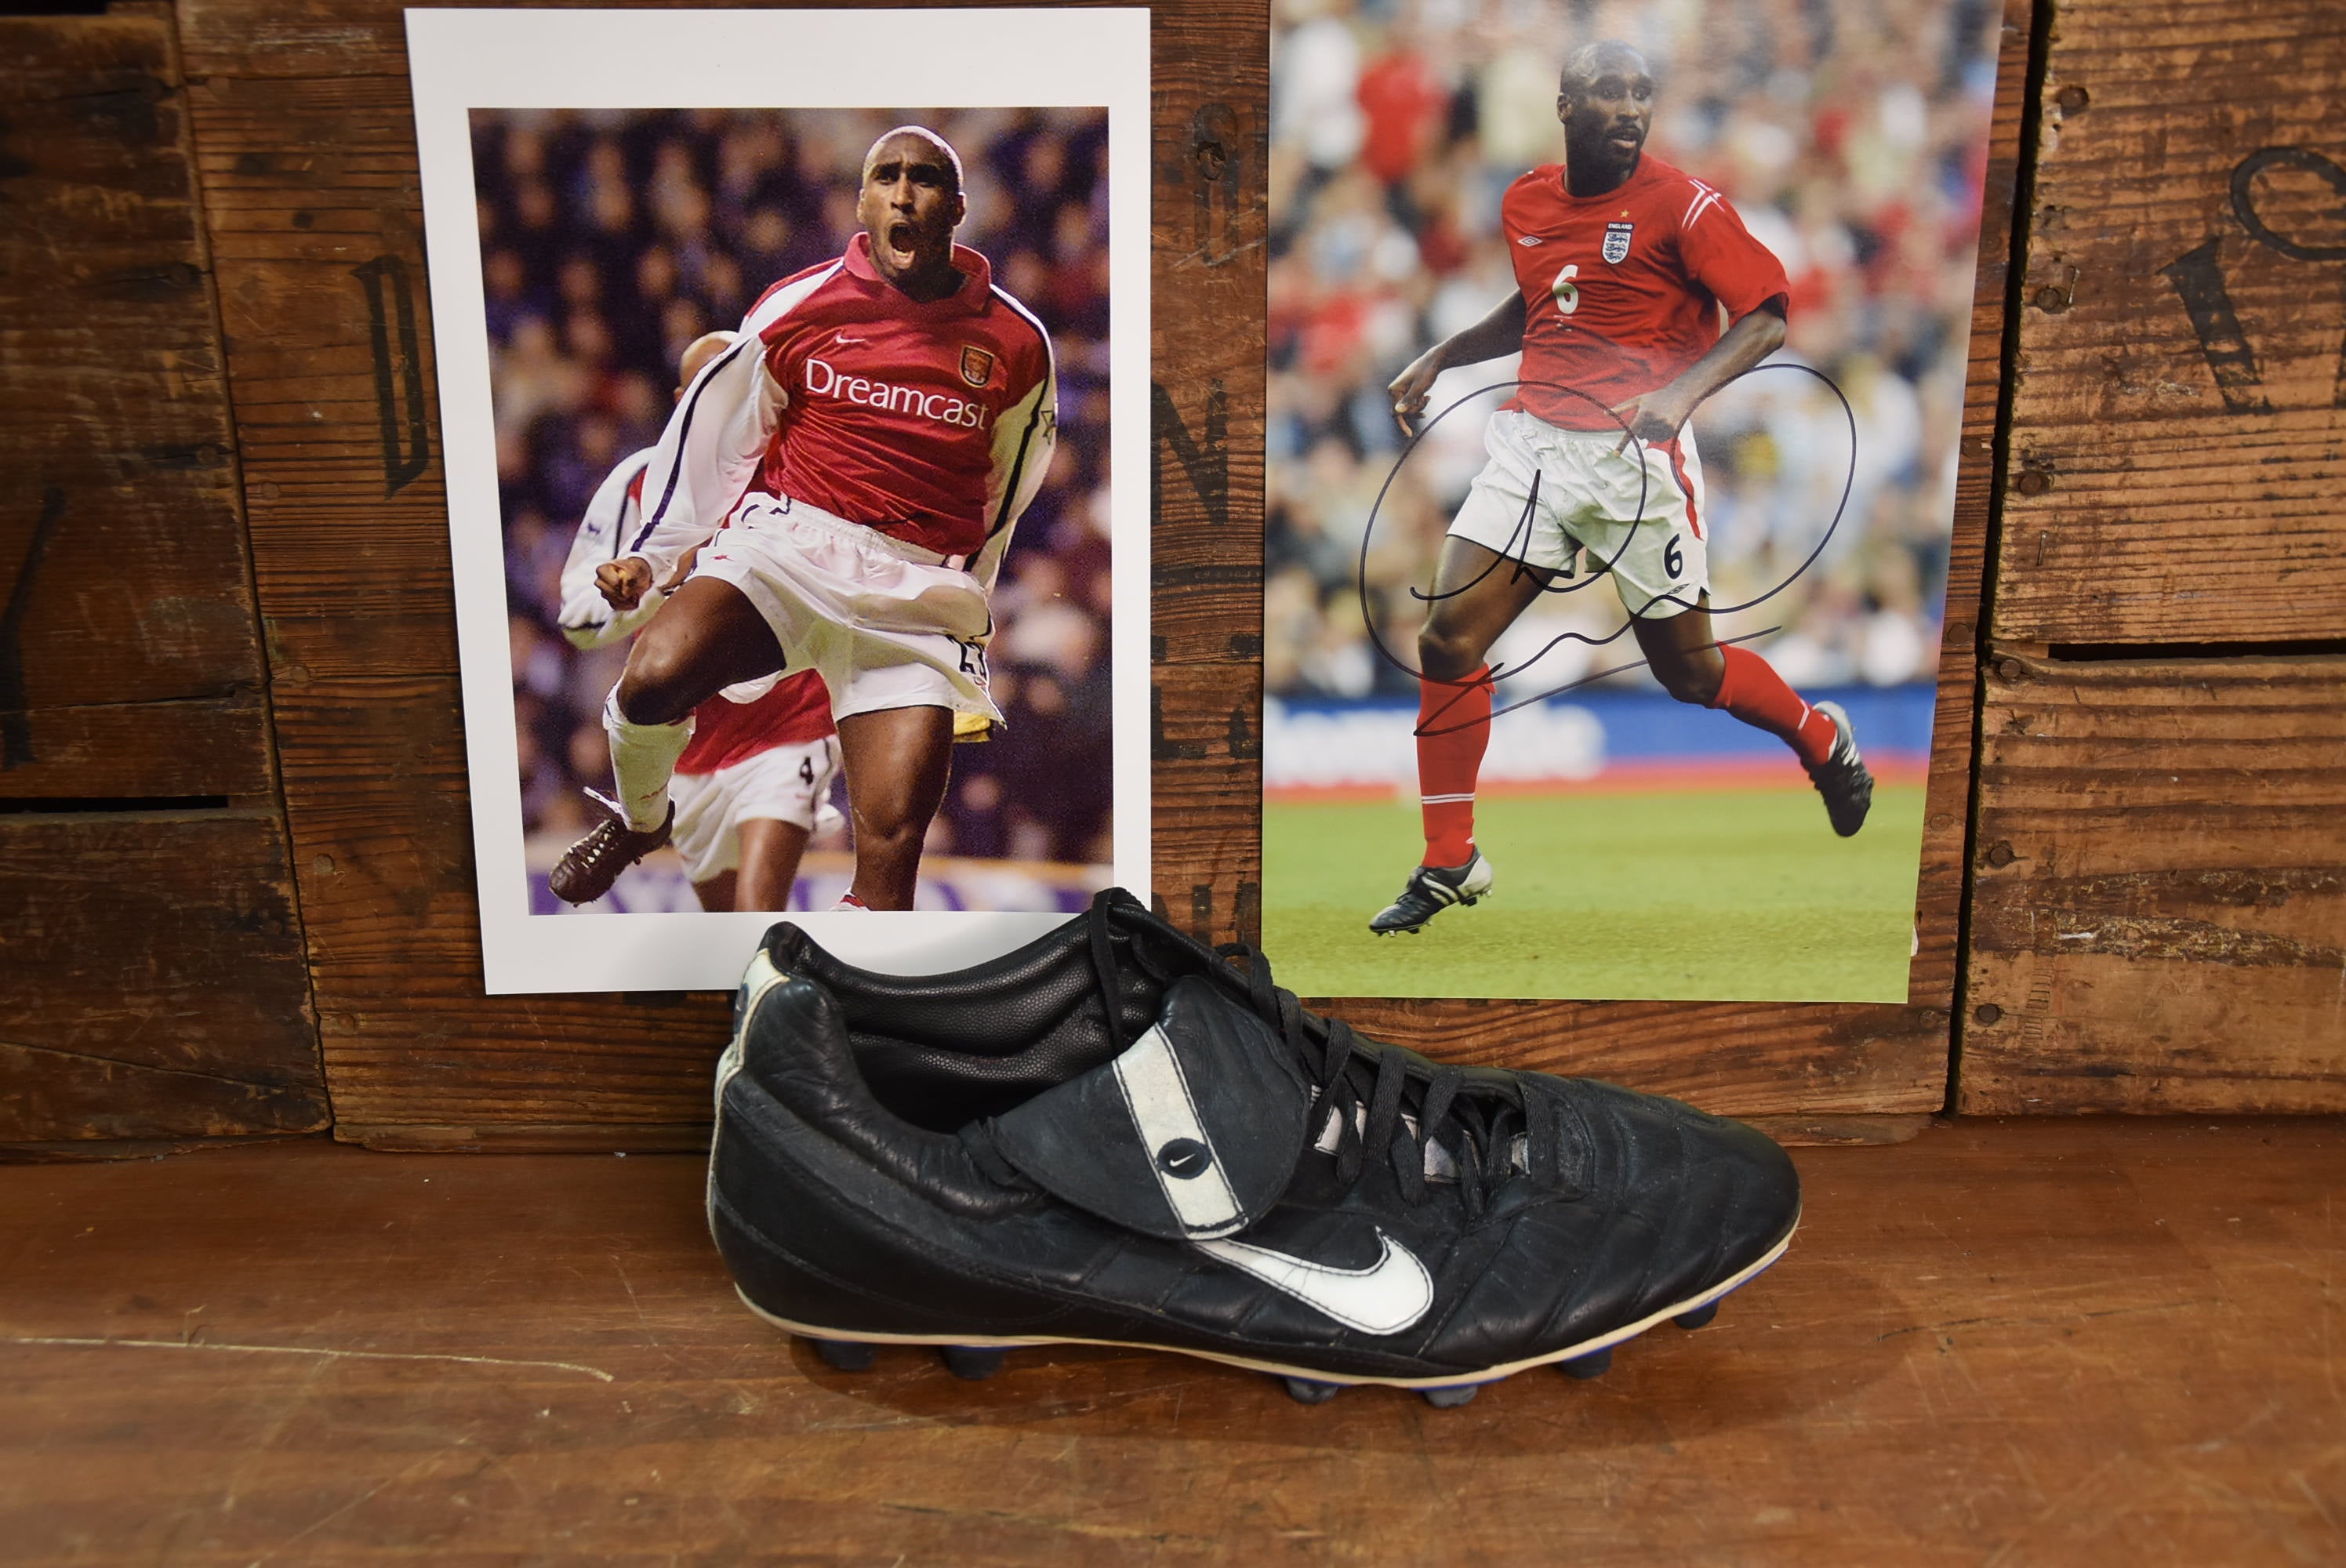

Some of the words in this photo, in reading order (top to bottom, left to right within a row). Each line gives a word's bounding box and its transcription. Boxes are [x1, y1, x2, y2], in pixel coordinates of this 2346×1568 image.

[1552, 264, 1579, 314] 6
[805, 358, 988, 431] Dreamcast
[1664, 532, 1683, 580] 6
[799, 756, 815, 786] 4
